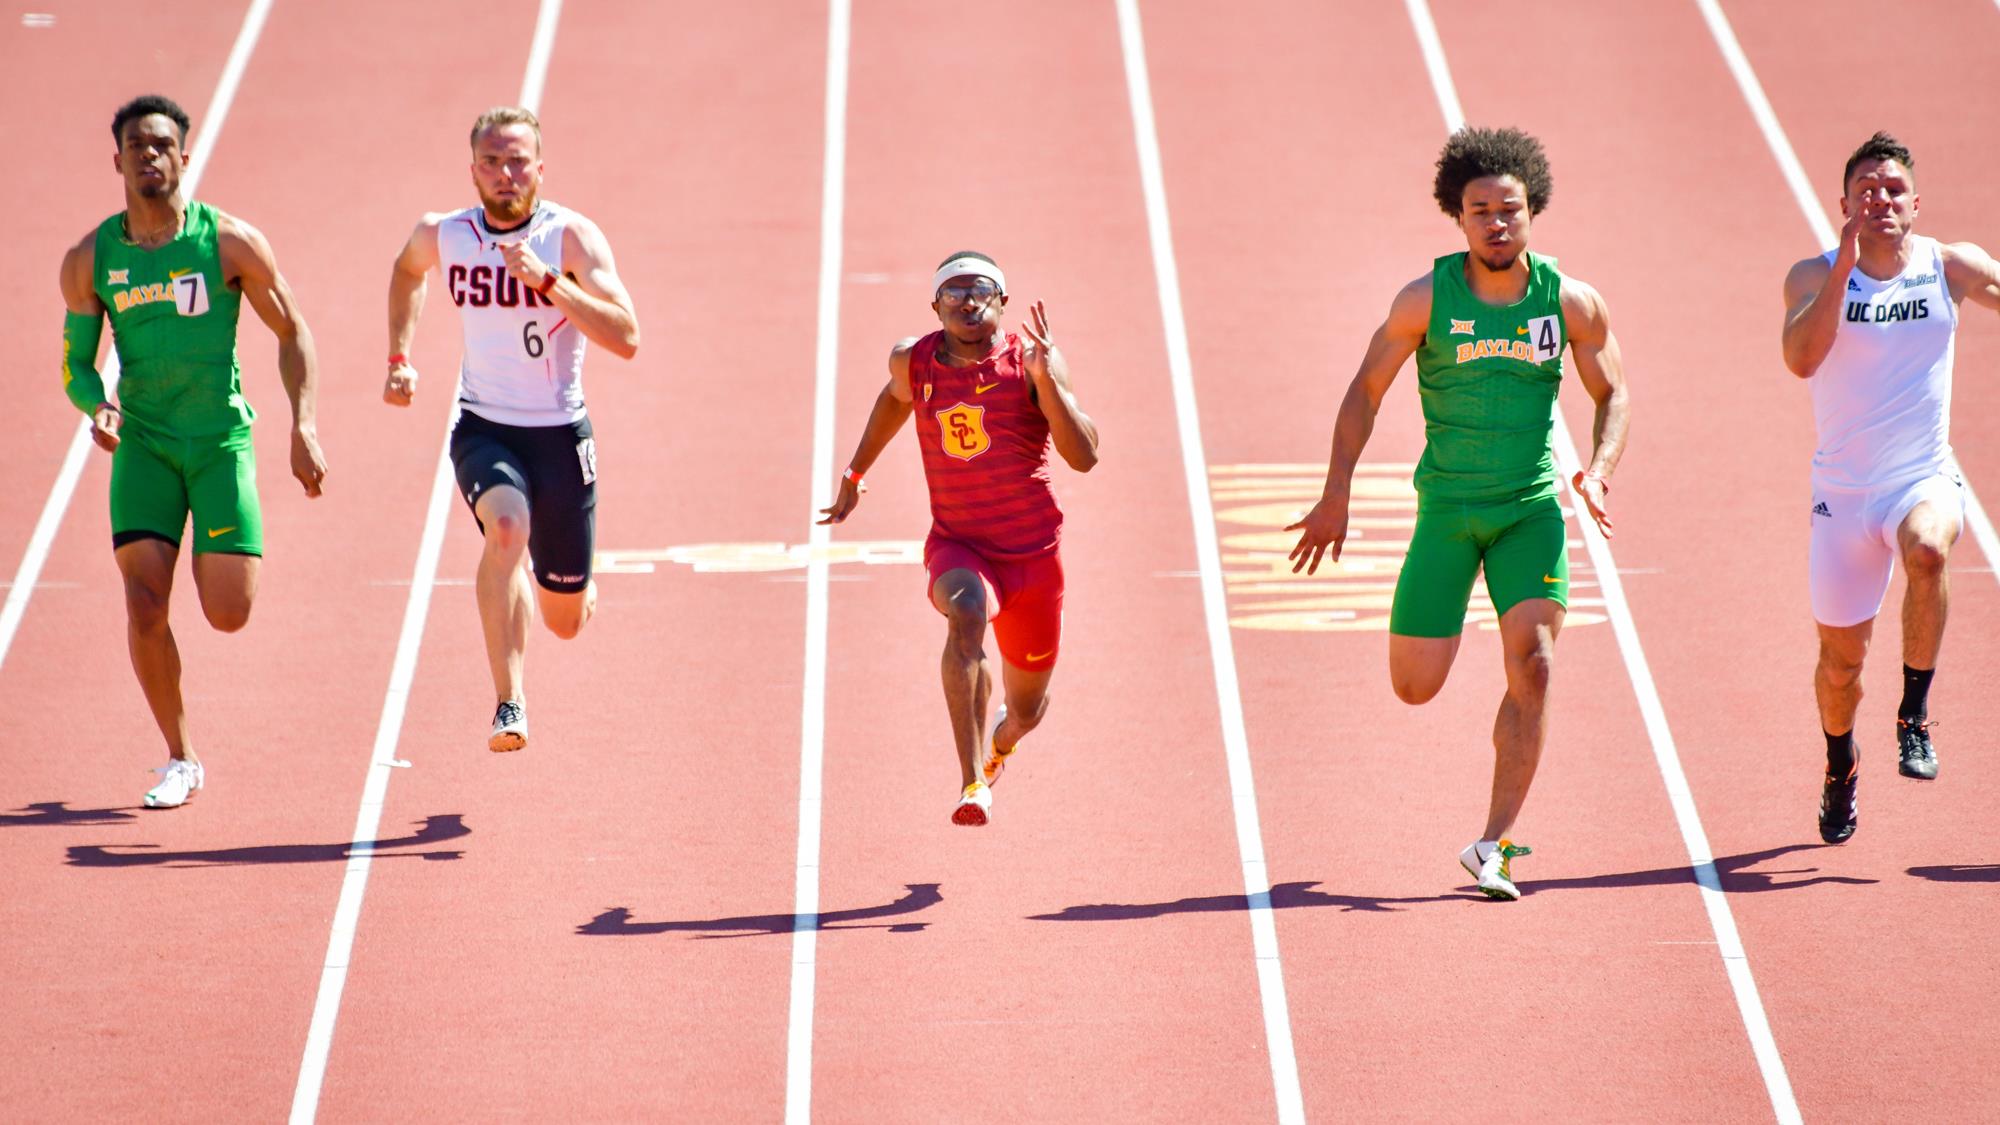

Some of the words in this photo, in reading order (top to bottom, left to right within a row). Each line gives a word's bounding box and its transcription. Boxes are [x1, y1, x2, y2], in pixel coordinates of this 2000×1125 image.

[180, 277, 197, 313] 7
[1846, 301, 1871, 322] UC
[1875, 298, 1928, 323] DAVIS
[523, 321, 544, 358] 6
[1538, 319, 1556, 356] 4
